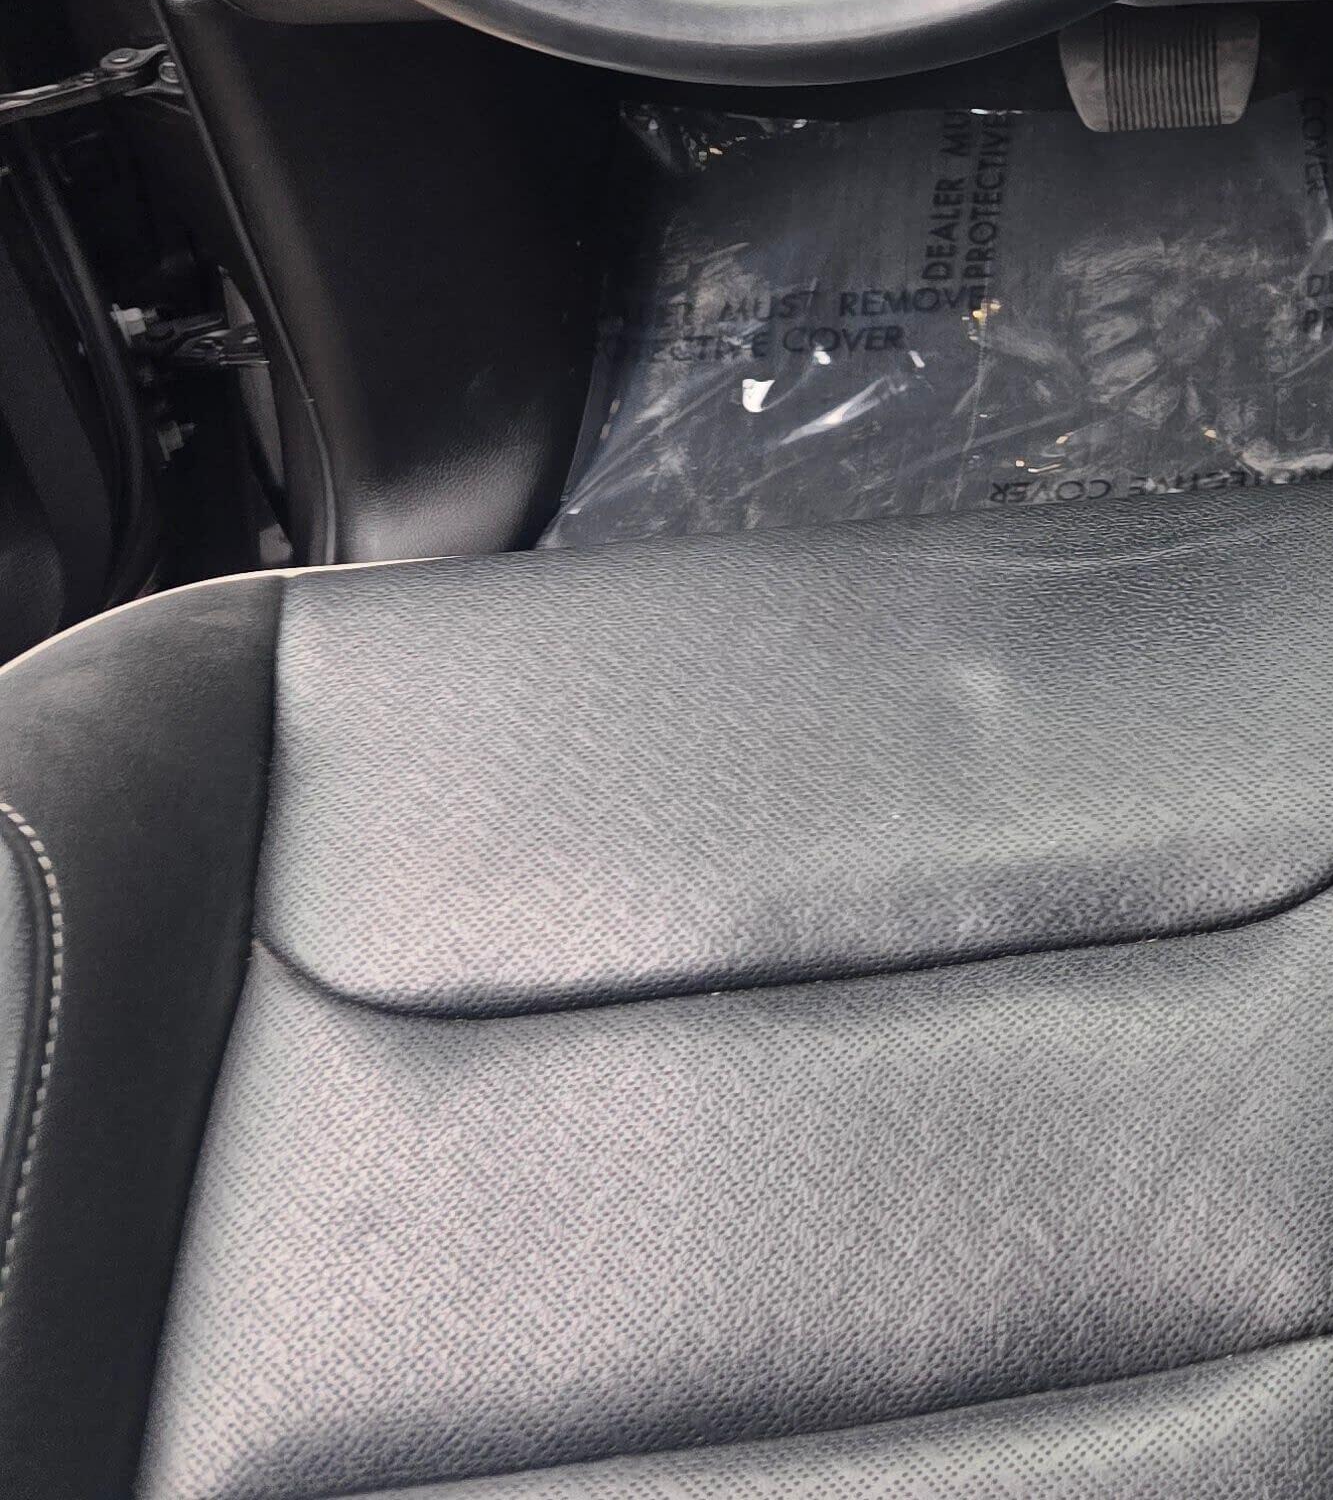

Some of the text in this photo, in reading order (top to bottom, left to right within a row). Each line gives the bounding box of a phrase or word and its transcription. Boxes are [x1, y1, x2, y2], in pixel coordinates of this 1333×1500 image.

[920, 178, 966, 281] DEALER
[963, 114, 1017, 282] PROTECTIVE
[838, 284, 988, 318] REMOVE
[781, 324, 905, 354] COVER
